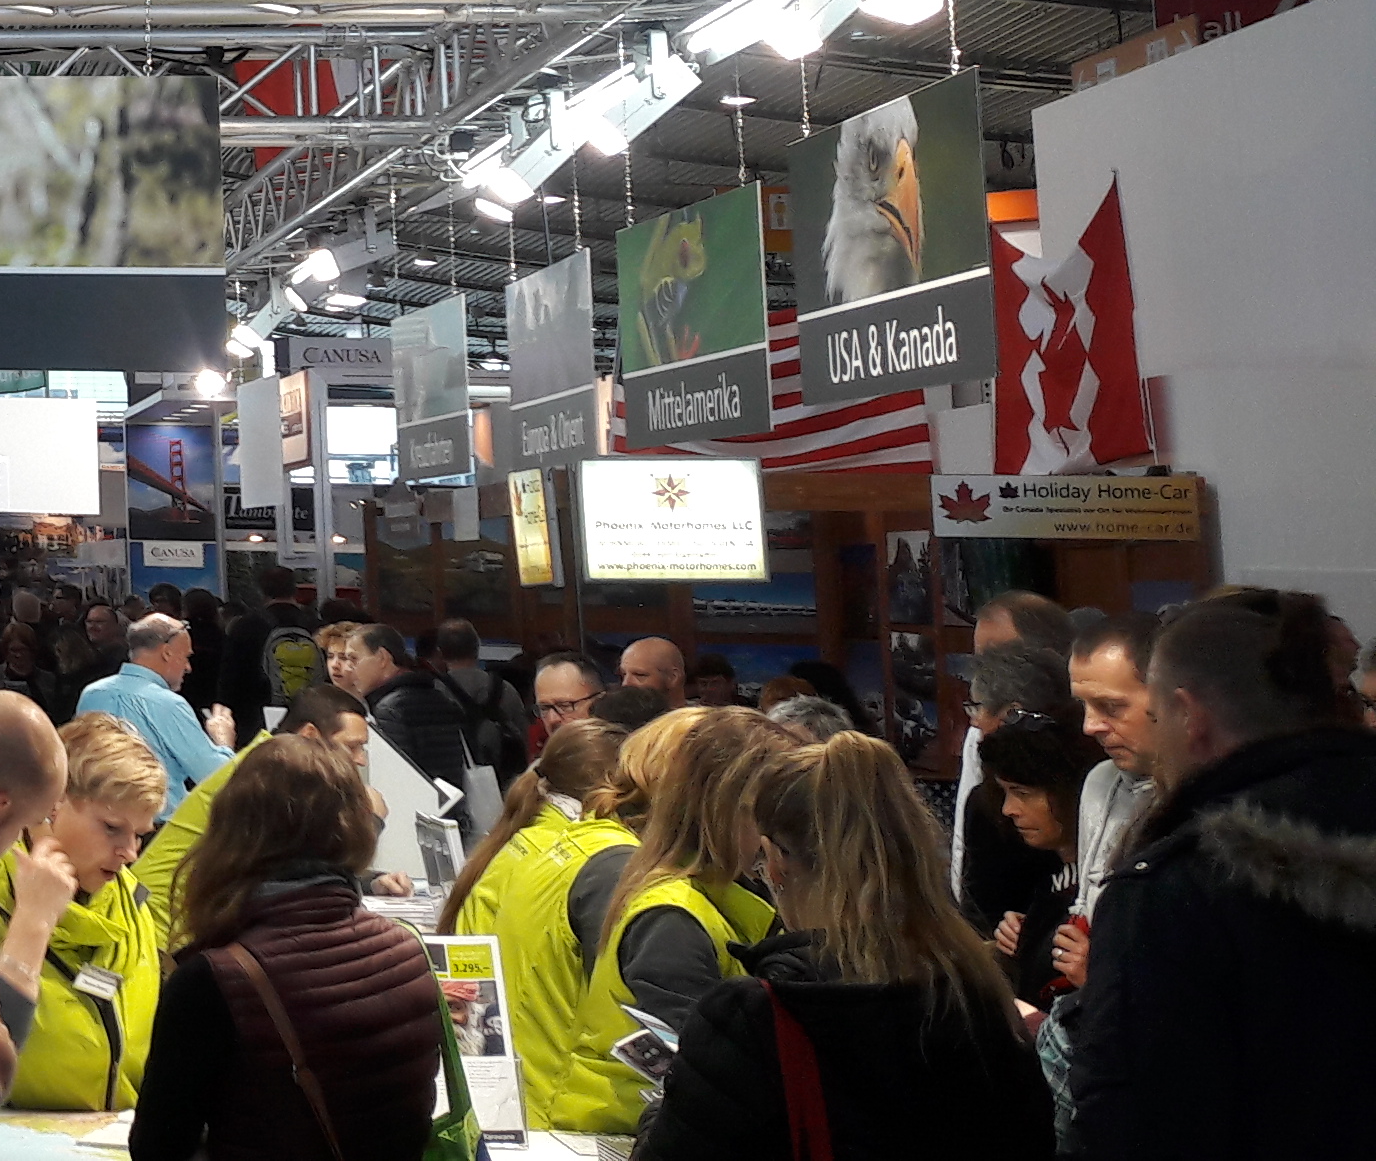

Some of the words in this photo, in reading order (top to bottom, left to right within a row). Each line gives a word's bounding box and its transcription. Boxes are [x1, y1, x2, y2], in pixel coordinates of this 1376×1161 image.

[1173, 11, 1243, 42] all
[828, 328, 865, 384] USA
[868, 324, 884, 377] &
[885, 305, 958, 374] Kanada
[303, 348, 382, 364] CANUSA
[648, 372, 742, 432] Mittelamerika
[1023, 483, 1092, 503] Holiday
[1098, 483, 1190, 500] Home-Car
[595, 521, 644, 530] Phoenix
[651, 521, 727, 530] Motorhomes
[150, 546, 196, 559] CANUSA
